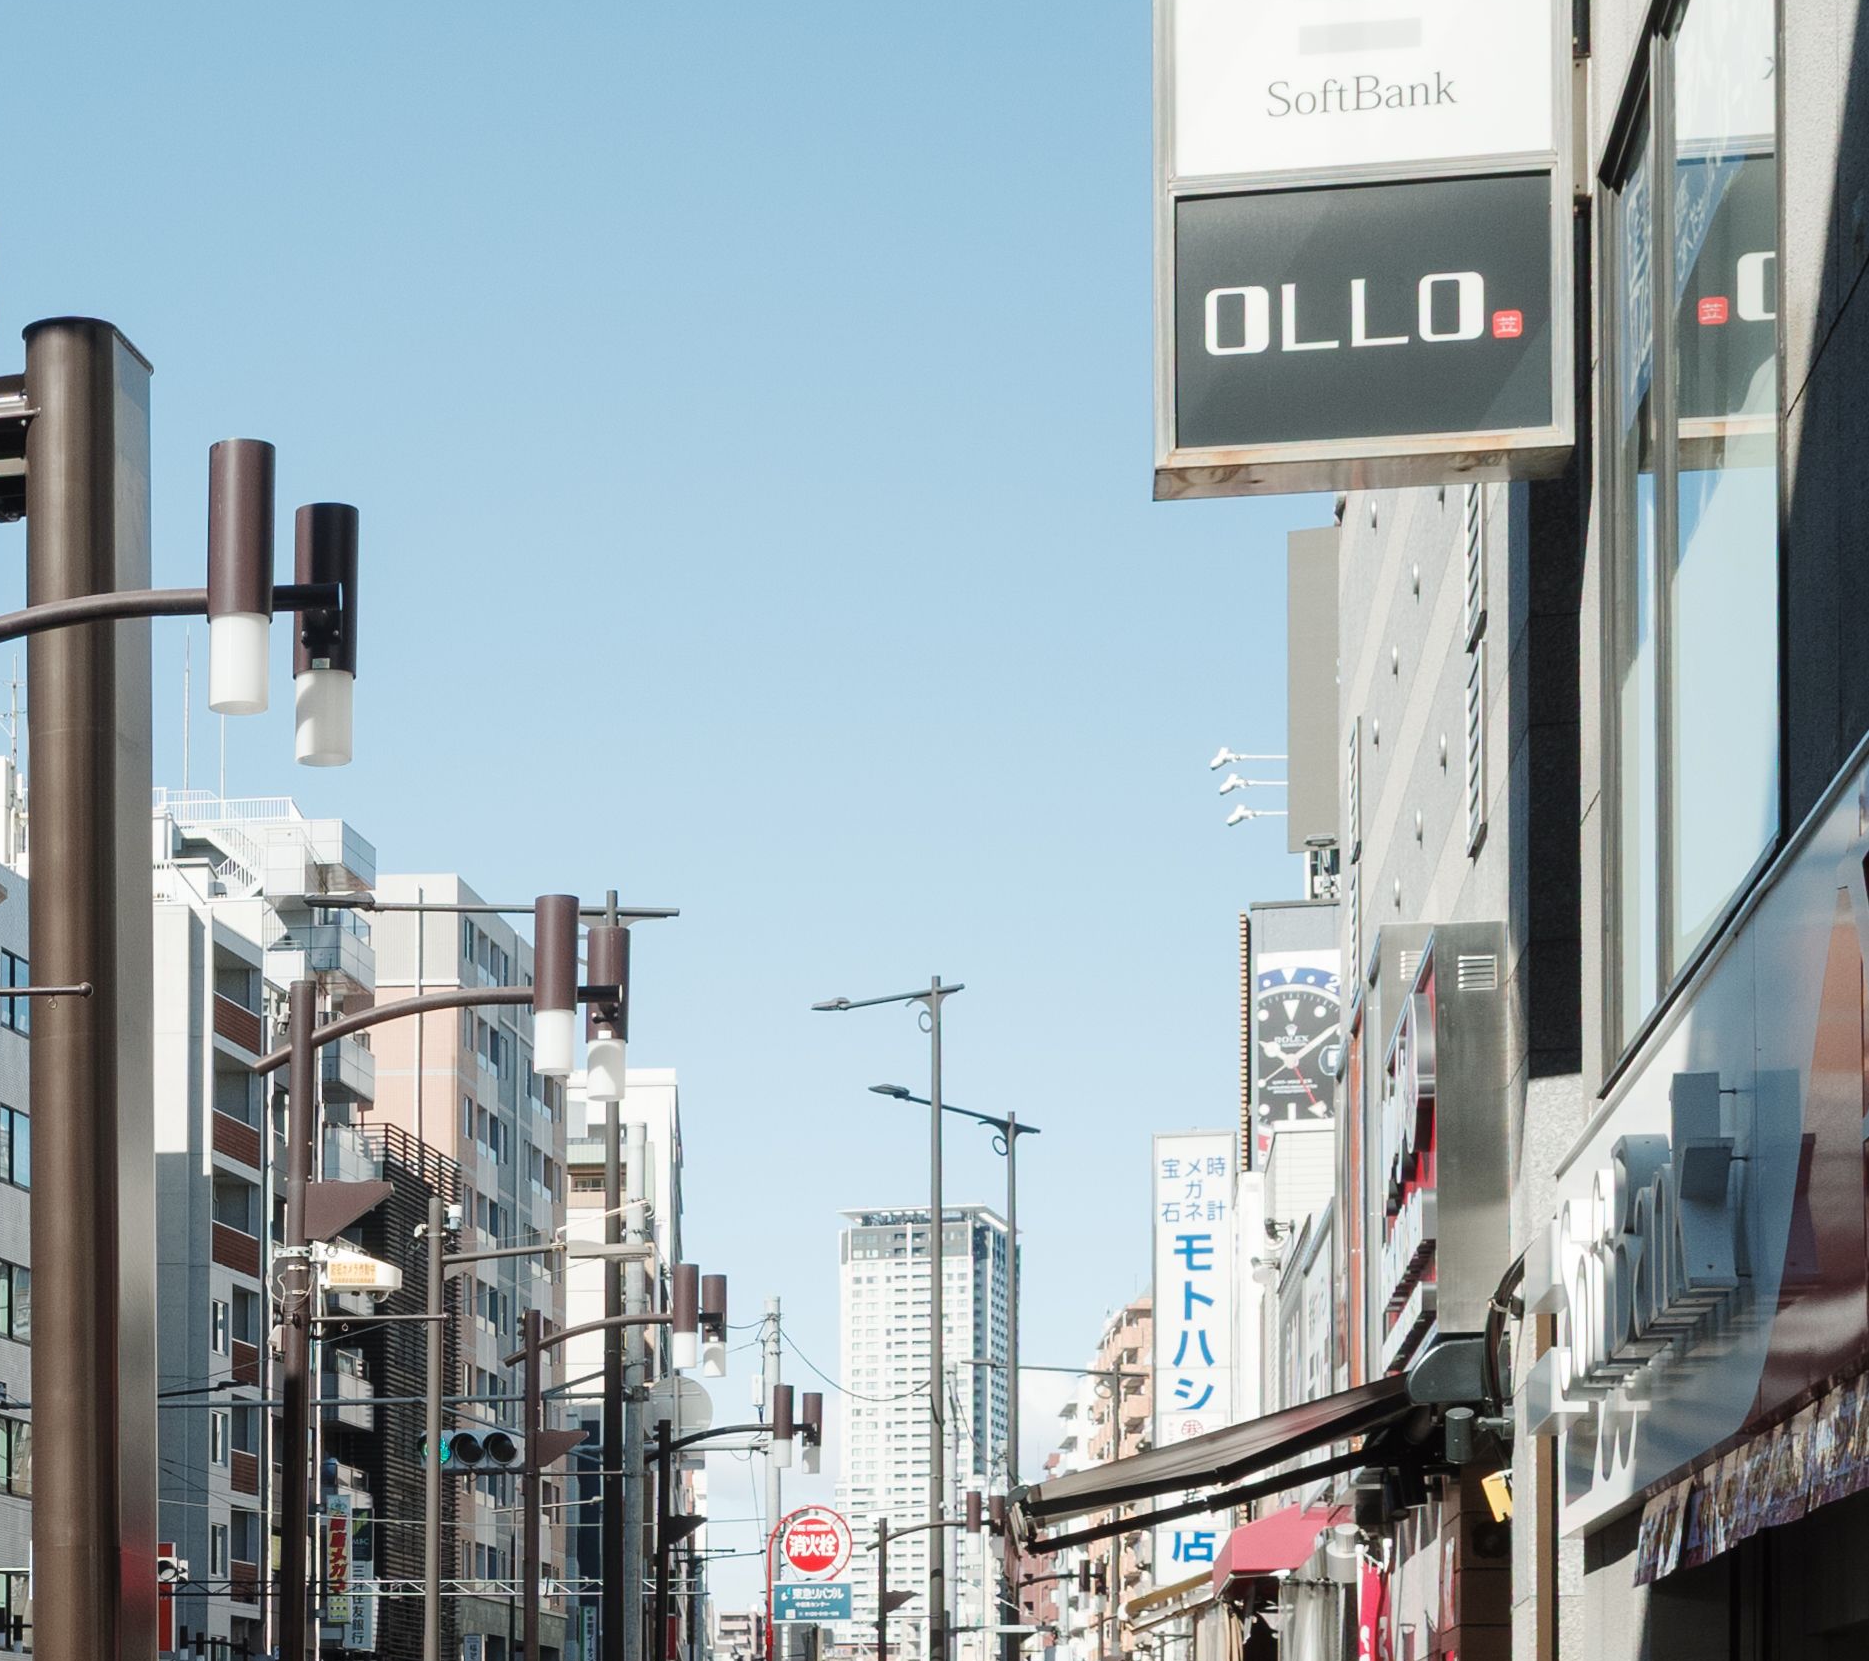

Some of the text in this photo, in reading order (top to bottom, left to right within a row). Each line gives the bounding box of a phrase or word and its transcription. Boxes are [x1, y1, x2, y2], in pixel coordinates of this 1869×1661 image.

[1266, 70, 1458, 119] SoftBank
[1205, 271, 1485, 357] OLLO
[1274, 1034, 1310, 1043] ROLEX
[1161, 1157, 1181, 1222] 宝石
[1185, 1157, 1203, 1221] メガネ
[1207, 1157, 1226, 1221] 時計
[1173, 1233, 1215, 1410] モトハシ
[788, 1533, 838, 1557] 消火栓
